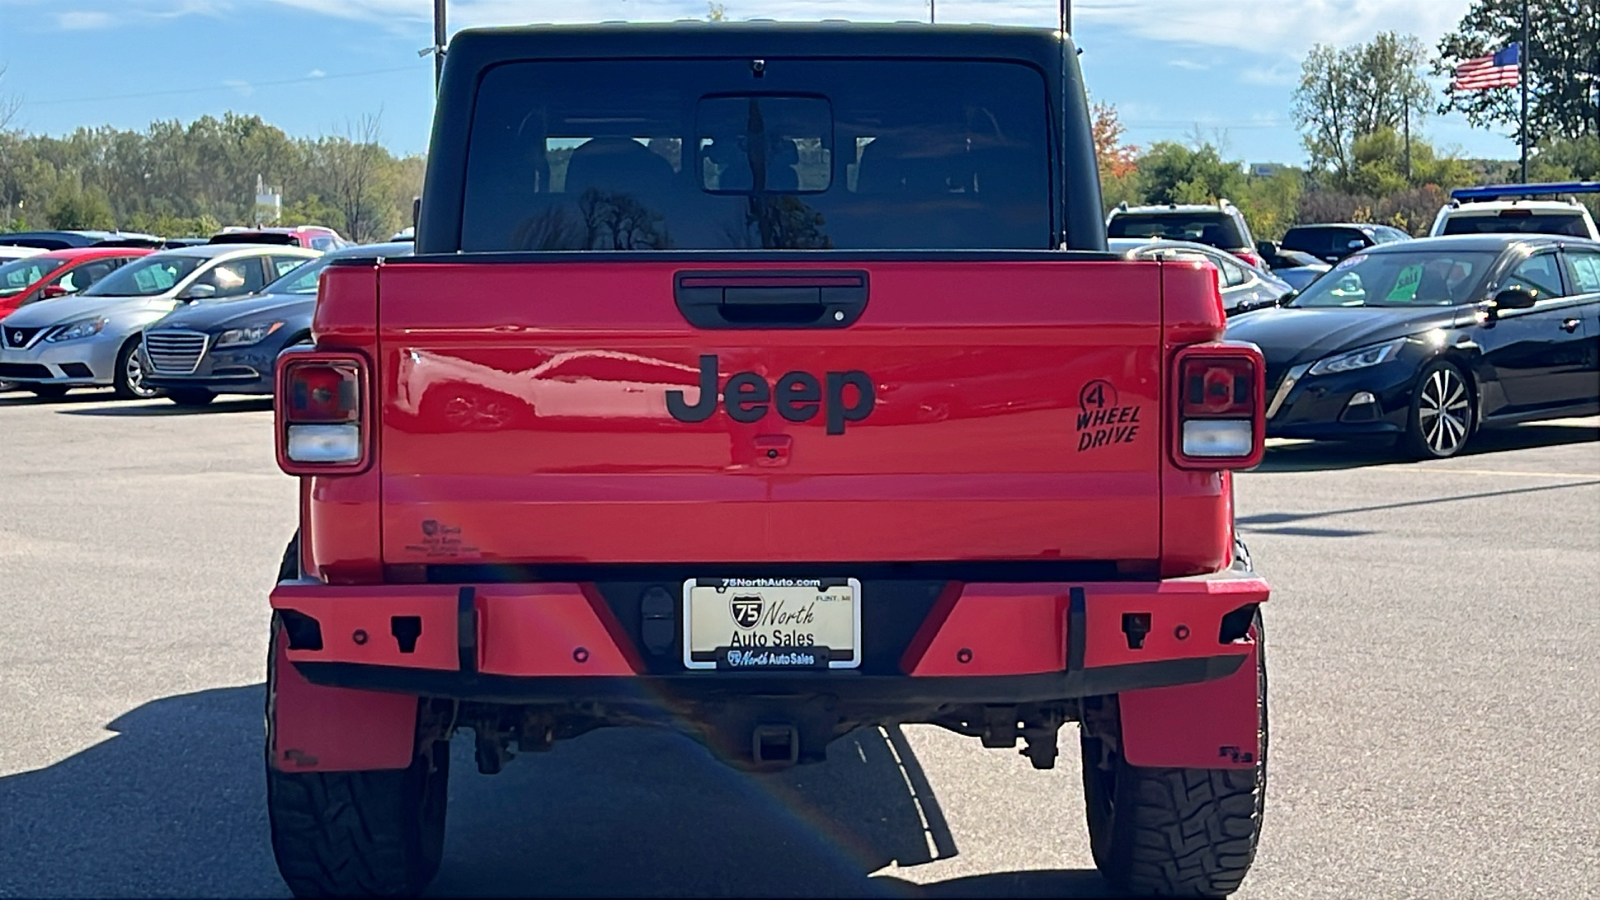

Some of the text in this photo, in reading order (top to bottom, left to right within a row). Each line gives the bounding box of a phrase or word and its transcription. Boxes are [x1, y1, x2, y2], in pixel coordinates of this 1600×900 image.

[665, 355, 875, 435] Jeep
[1086, 385, 1105, 408] 4
[1077, 406, 1141, 431] WHEEL
[1078, 426, 1140, 452] DRIVE
[722, 578, 821, 587] 75NorthAuto.com
[735, 600, 815, 626] 75 North
[730, 629, 815, 647] Auto Sales
[740, 650, 769, 666] North
[769, 653, 790, 665] Auto
[790, 652, 815, 665] Sales
